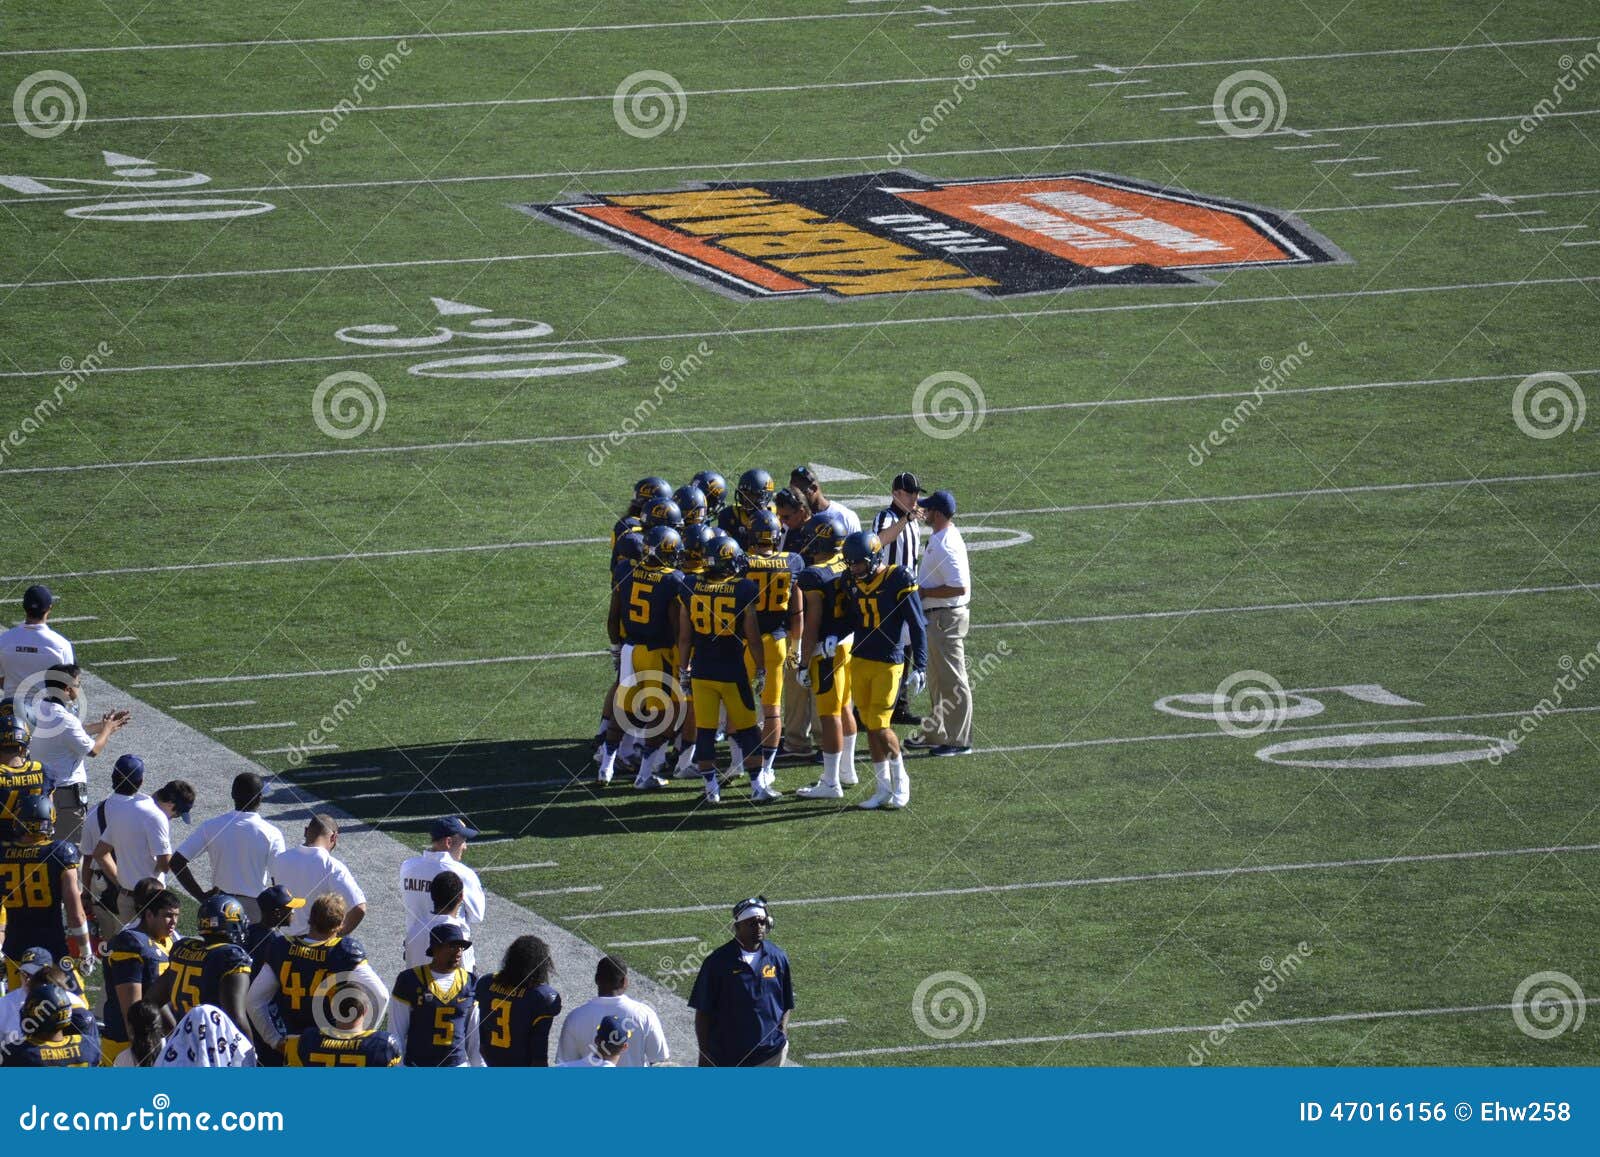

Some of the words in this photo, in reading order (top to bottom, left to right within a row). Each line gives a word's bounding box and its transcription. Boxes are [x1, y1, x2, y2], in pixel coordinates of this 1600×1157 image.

[604, 187, 1001, 296] KABAM
[867, 214, 1008, 254] FIELD
[629, 582, 653, 624] 5
[690, 594, 736, 636] 86
[857, 598, 881, 628] 11
[0, 863, 52, 908] 38
[170, 961, 203, 1013] 75
[762, 964, 776, 978] Cal
[432, 1006, 456, 1046] 5
[490, 998, 512, 1048] 3
[40, 1045, 81, 1061] BENNETT
